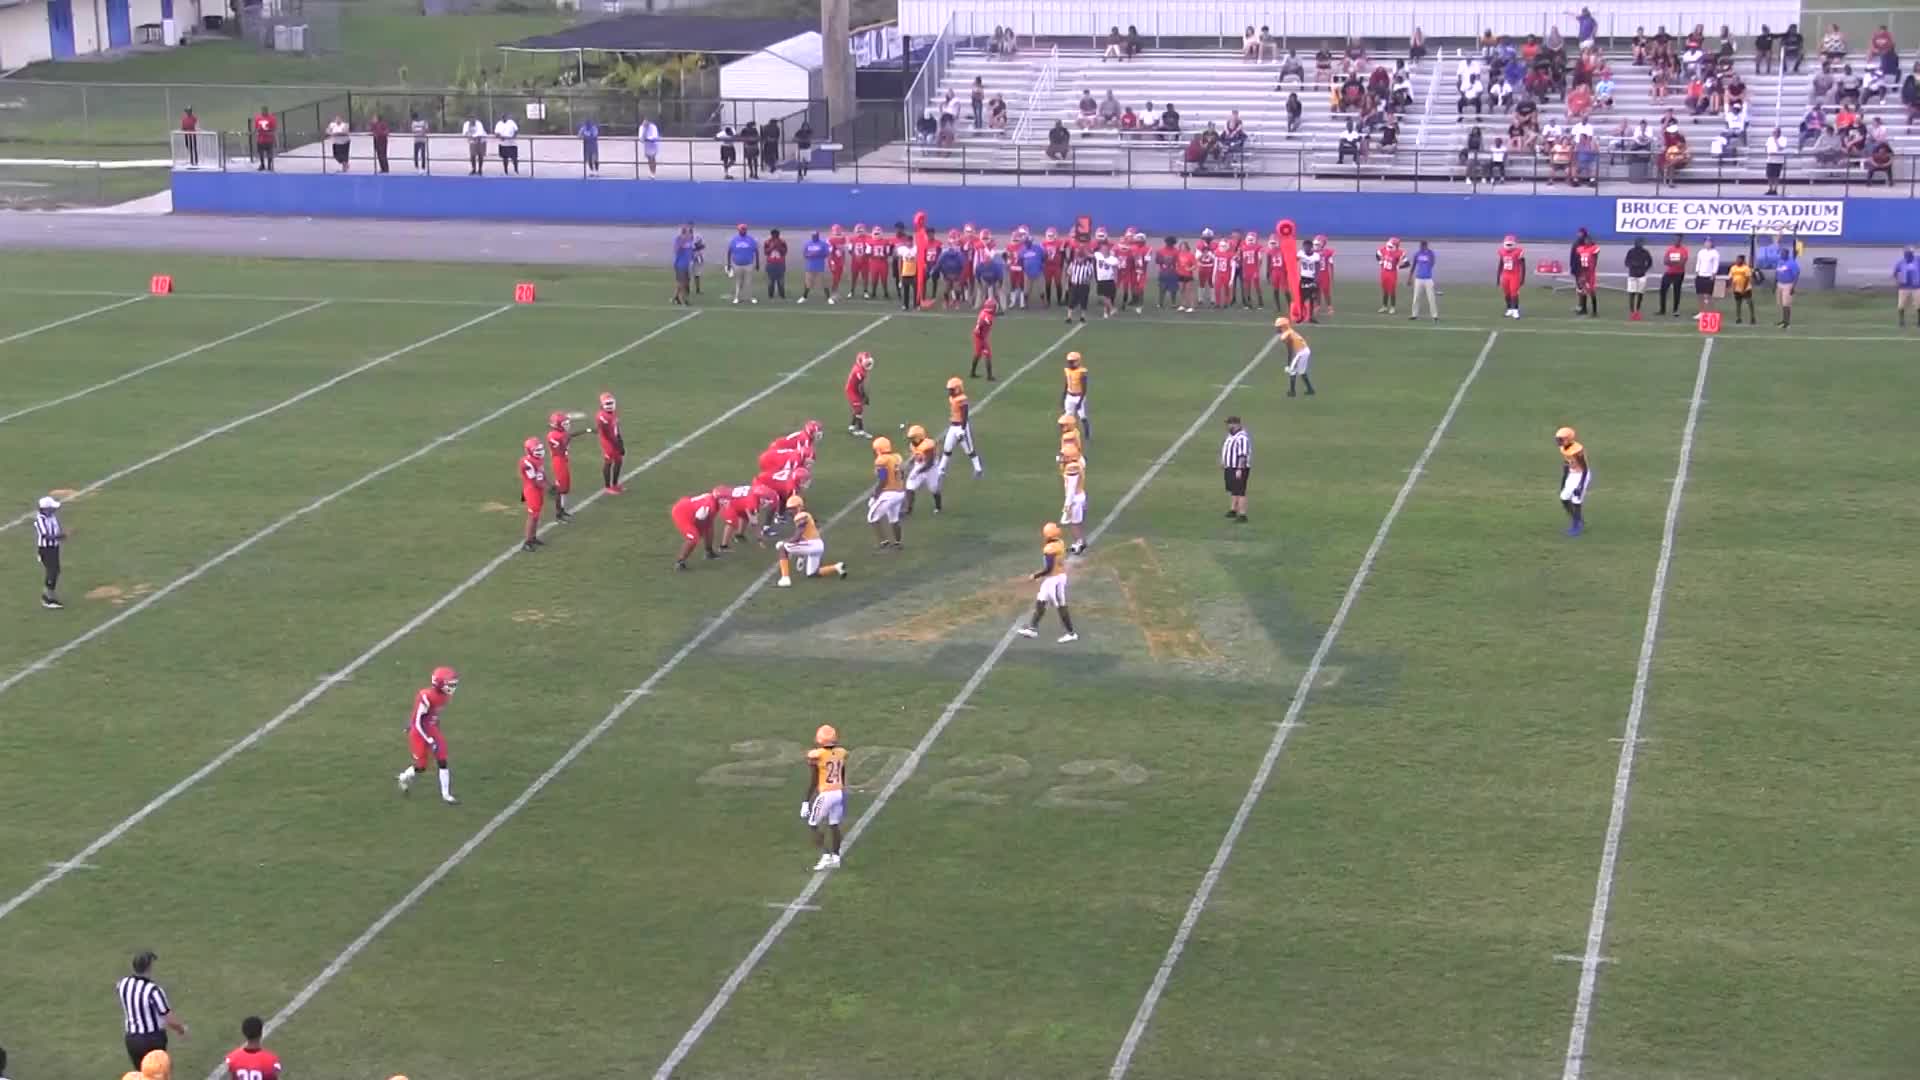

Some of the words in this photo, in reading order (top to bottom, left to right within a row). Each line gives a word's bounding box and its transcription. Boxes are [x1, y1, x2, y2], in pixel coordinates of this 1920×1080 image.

[1621, 202, 1679, 214] BRUCE
[1683, 202, 1754, 215] CANOVA
[1757, 203, 1839, 216] STADIUM
[1620, 217, 1678, 229] HOME
[1684, 218, 1710, 230] OF
[1717, 218, 1752, 231] THE
[154, 279, 168, 291] 10
[517, 286, 532, 300] 20
[825, 760, 841, 784] 24
